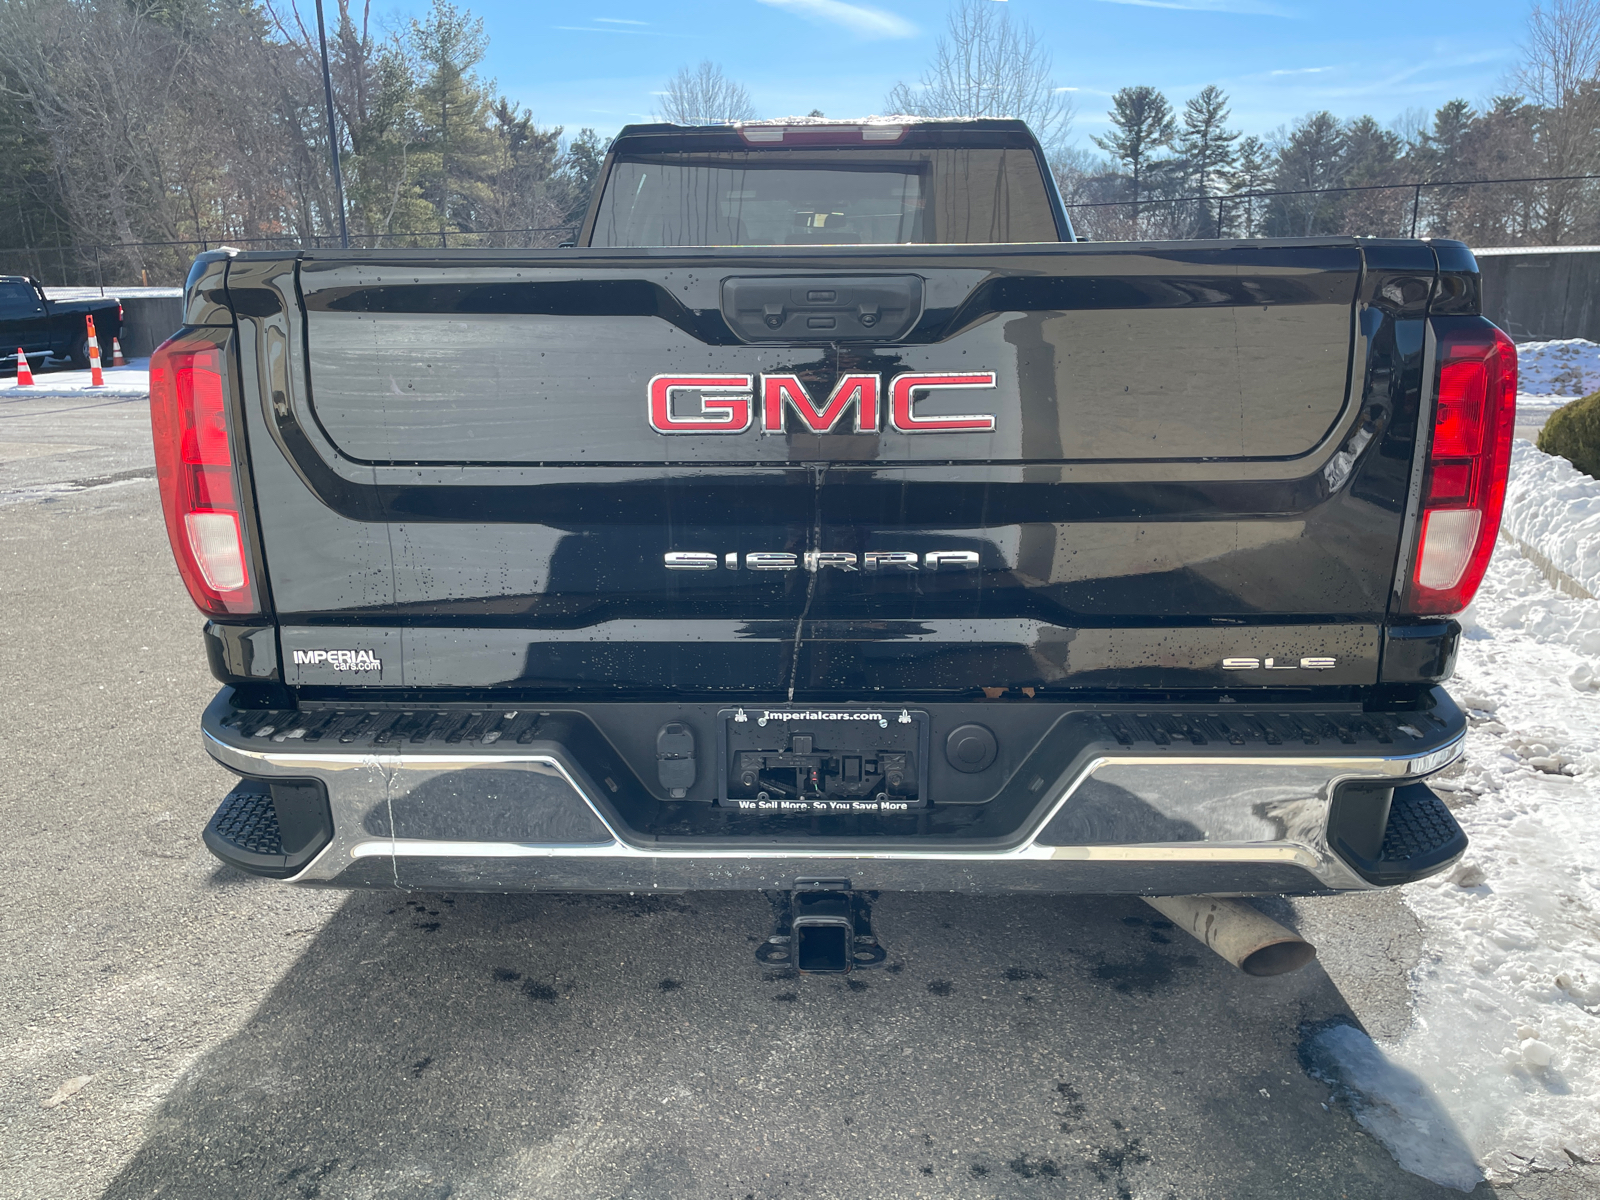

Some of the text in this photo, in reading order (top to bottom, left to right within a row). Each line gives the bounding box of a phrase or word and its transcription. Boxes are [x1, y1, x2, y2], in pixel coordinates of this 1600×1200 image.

[648, 372, 997, 434] GMC
[663, 550, 981, 572] SIERRA
[293, 650, 380, 664] IMPERIAL
[1222, 656, 1337, 670] SLE
[333, 662, 381, 671] cars.com
[763, 710, 883, 722] Imperialcars.com
[738, 800, 757, 809] We
[758, 800, 778, 809] Sell
[812, 801, 827, 809] So
[829, 801, 850, 809] You
[852, 801, 879, 810] Save
[880, 801, 908, 810] More
